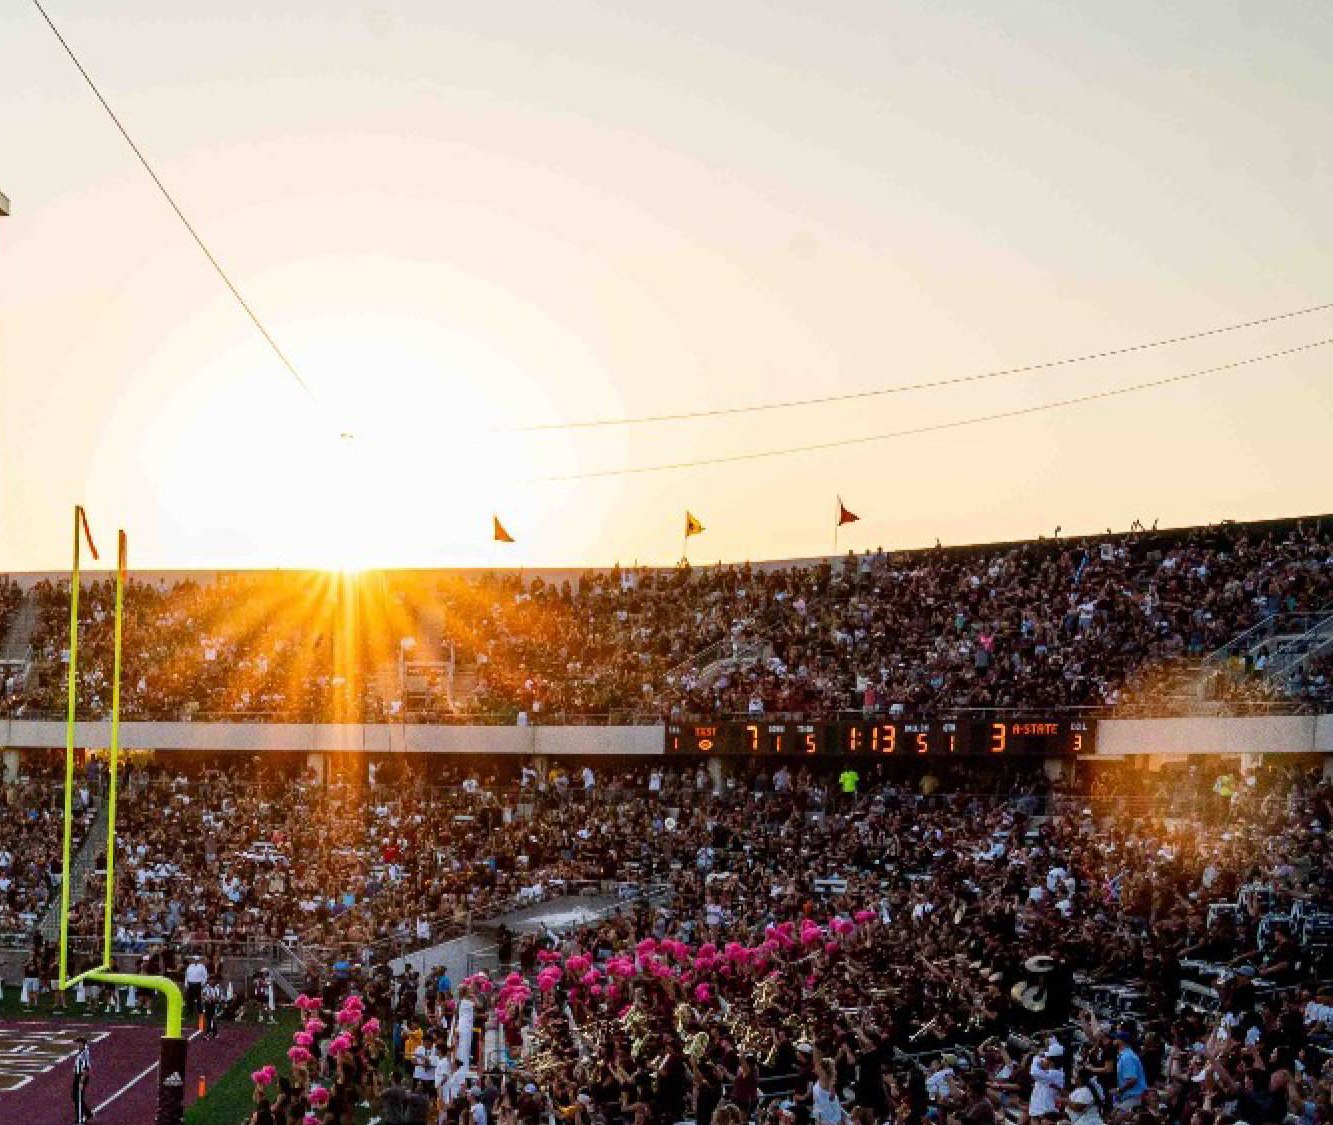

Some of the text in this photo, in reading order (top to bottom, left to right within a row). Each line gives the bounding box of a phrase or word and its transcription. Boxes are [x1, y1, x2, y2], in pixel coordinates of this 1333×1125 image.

[746, 725, 758, 750] 7
[992, 723, 1006, 752] 3
[1012, 723, 1060, 735] A-STATE
[806, 735, 815, 752] 5
[850, 726, 896, 752] 1:13
[917, 733, 928, 752] 5
[1073, 734, 1082, 751] 3
